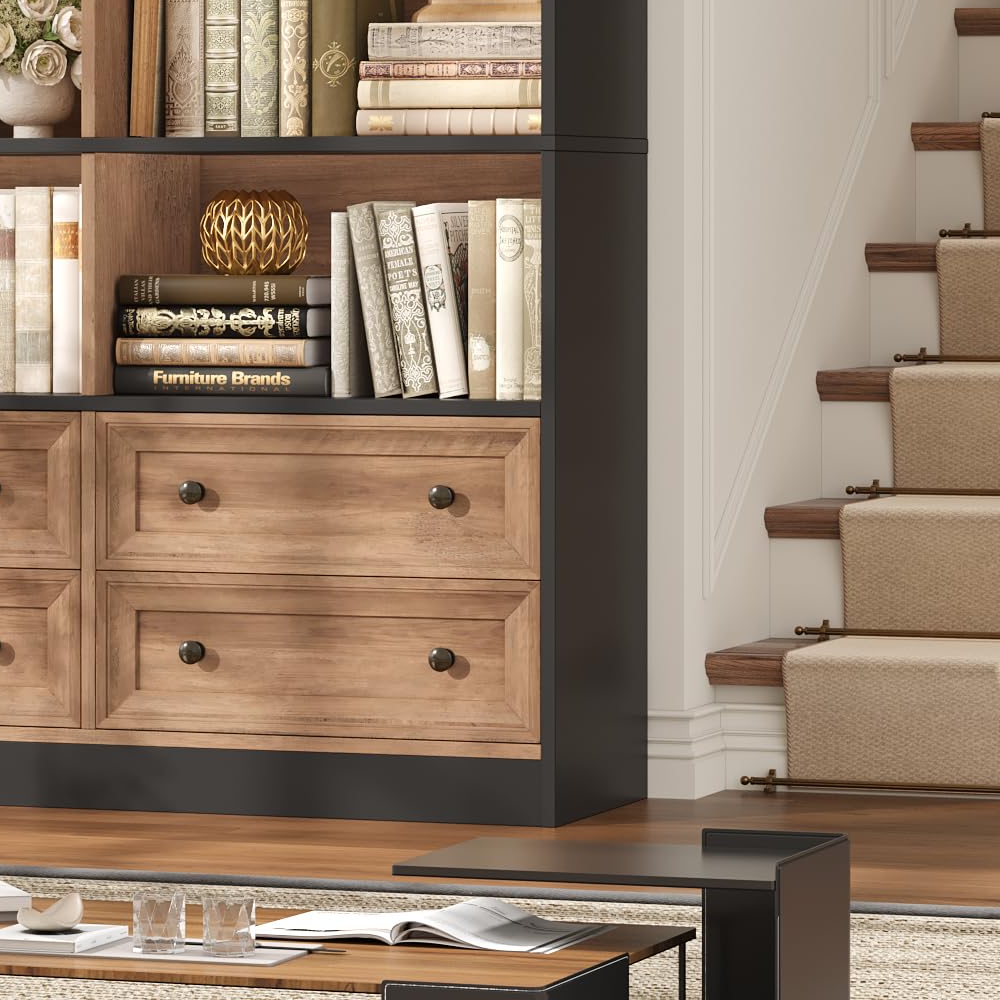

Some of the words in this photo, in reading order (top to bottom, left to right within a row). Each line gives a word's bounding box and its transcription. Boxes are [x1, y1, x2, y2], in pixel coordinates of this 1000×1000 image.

[387, 268, 418, 281] POETS
[153, 370, 228, 386] Furniture
[231, 371, 291, 387] Brands
